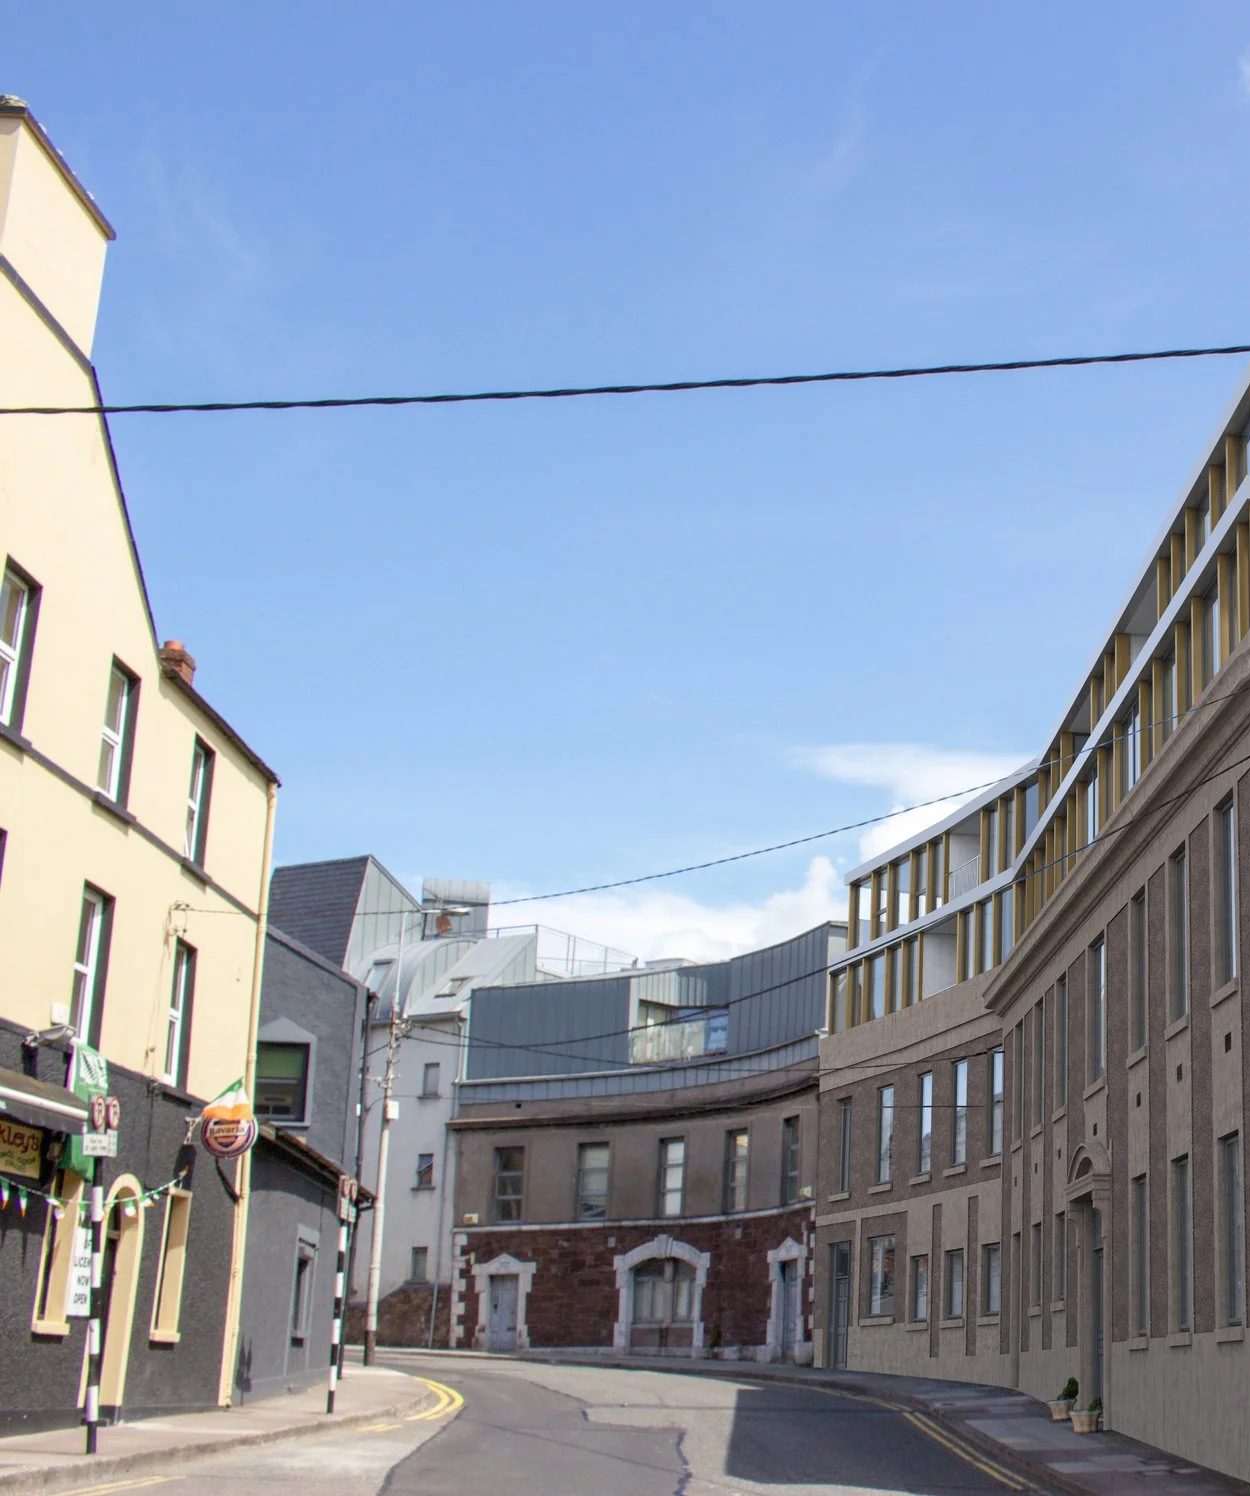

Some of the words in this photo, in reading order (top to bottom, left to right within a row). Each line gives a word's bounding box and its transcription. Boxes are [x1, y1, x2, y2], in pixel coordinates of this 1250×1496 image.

[209, 1125, 245, 1136] Bavaria
[74, 1255, 91, 1268] LICEN
[77, 1276, 89, 1286] NOW
[73, 1293, 88, 1304] OPEN
